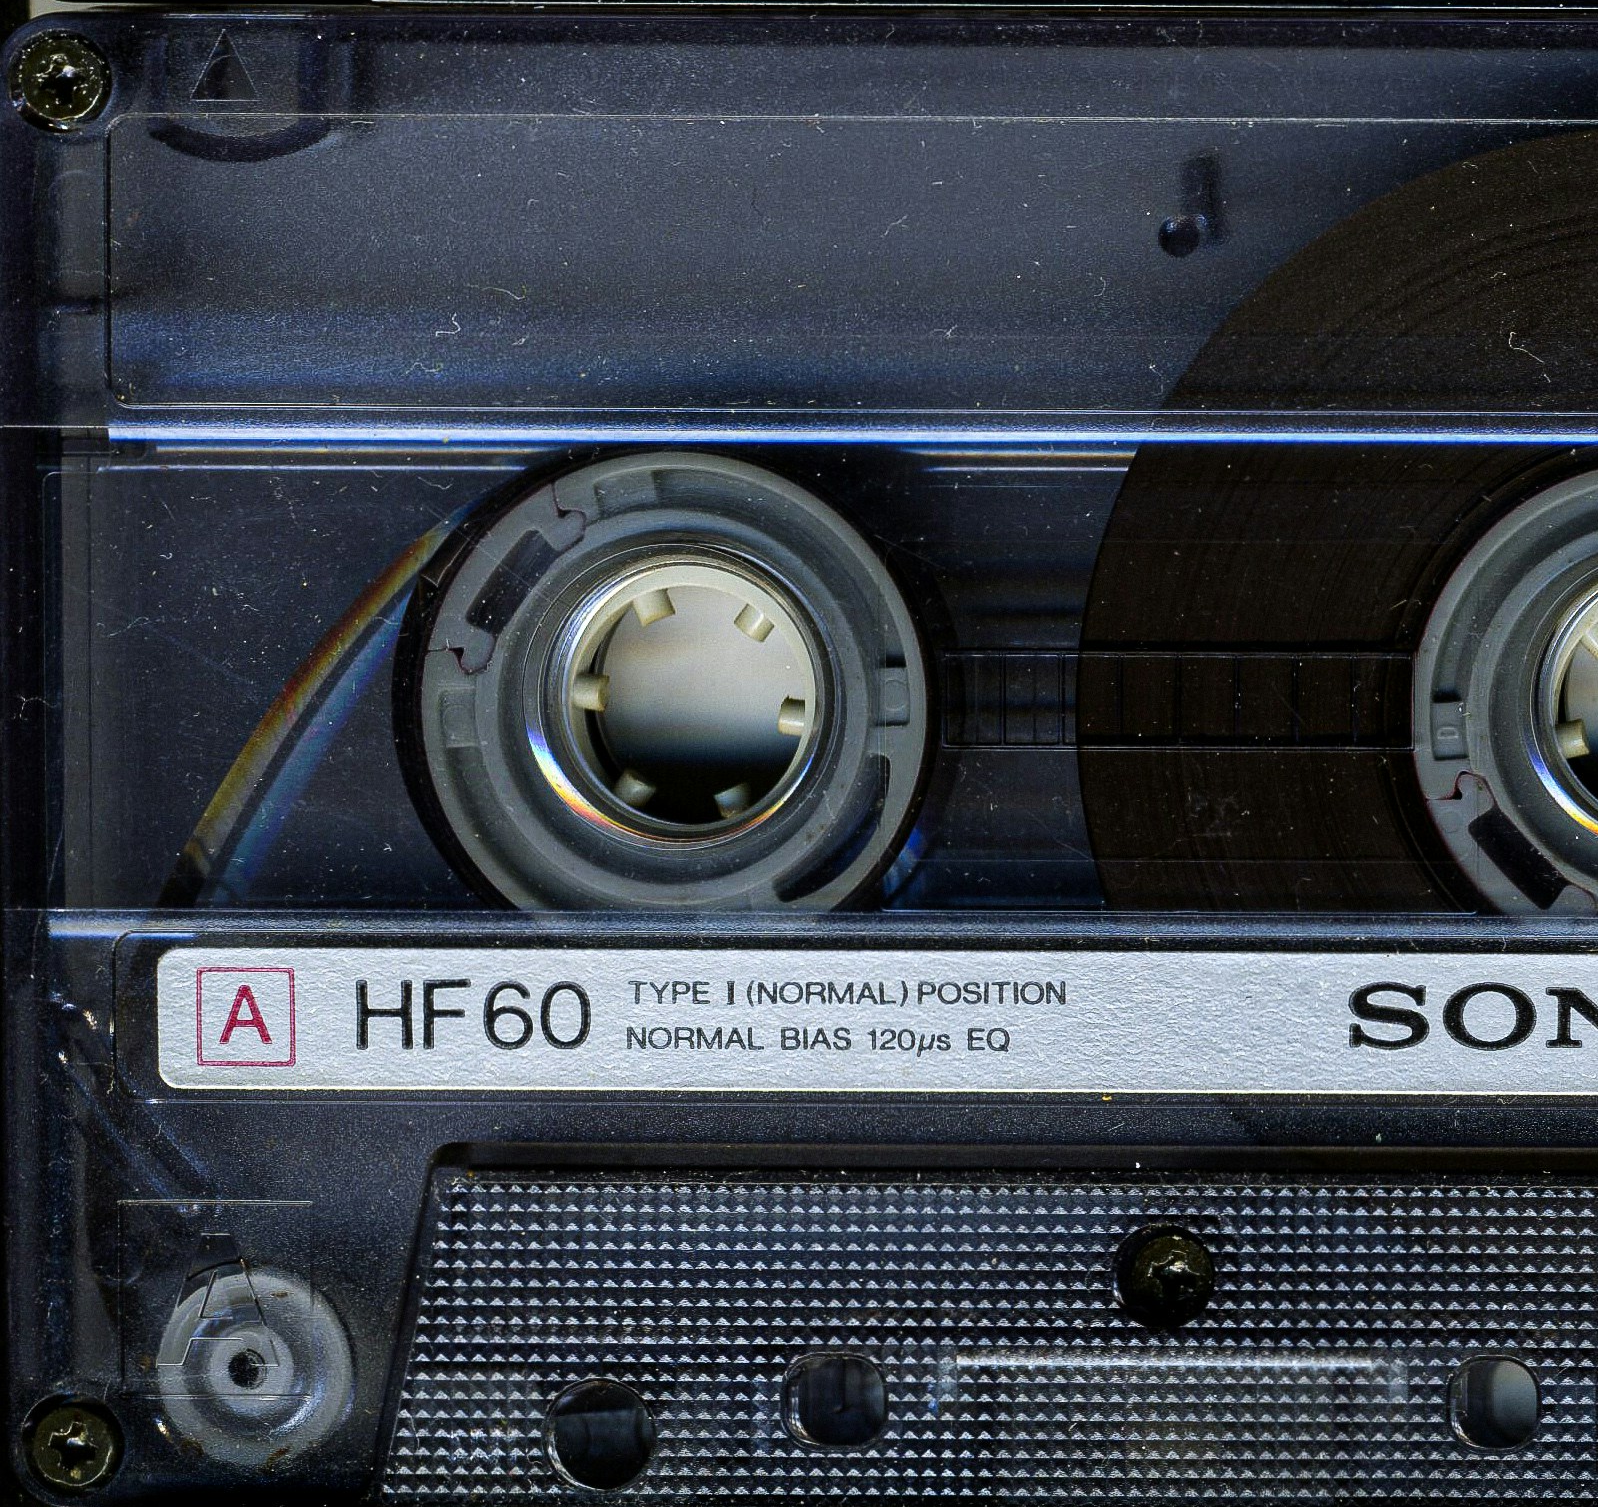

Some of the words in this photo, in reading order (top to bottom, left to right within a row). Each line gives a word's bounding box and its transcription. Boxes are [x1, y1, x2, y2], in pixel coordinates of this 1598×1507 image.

[628, 980, 711, 1006] TYPE
[726, 980, 737, 1006] I
[747, 979, 909, 1009] (NORMAL)
[918, 980, 1067, 1006] POSITION
[219, 984, 272, 1045] A
[627, 1026, 765, 1051] NORMAL
[780, 1026, 852, 1051] BIAS
[967, 1026, 1012, 1053] EQ
